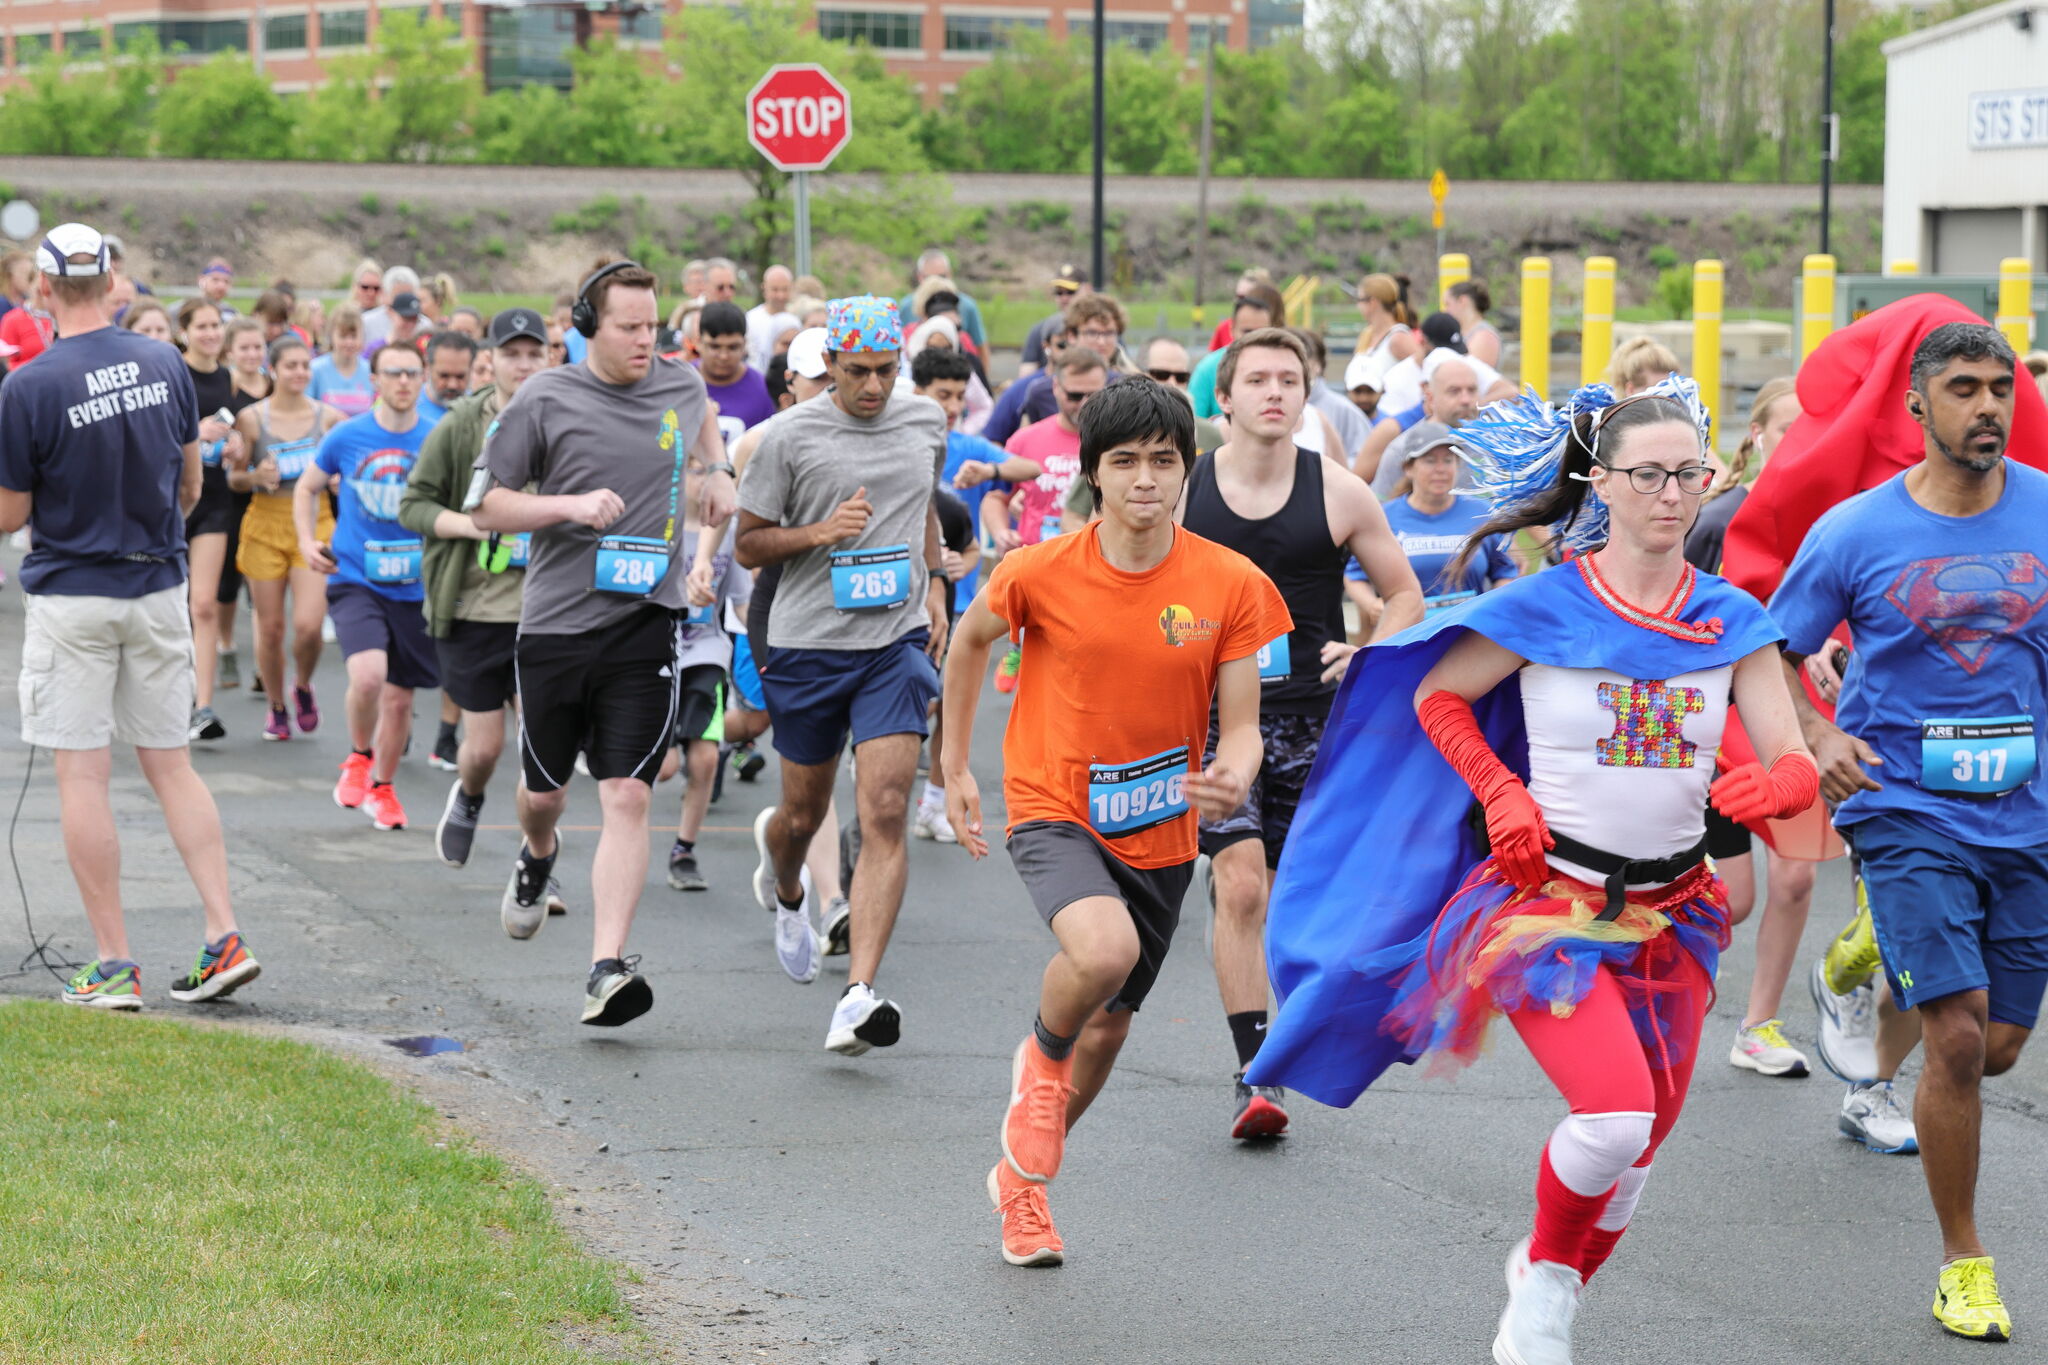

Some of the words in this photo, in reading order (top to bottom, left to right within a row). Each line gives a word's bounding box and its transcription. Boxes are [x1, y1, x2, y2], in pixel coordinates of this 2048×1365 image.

[756, 96, 844, 139] STOP
[1974, 100, 2012, 141] STS
[84, 360, 141, 397] AREEP
[67, 391, 122, 430] EVENT
[122, 380, 169, 413] STAFF
[612, 557, 656, 587] 284
[849, 568, 898, 600] 263
[1926, 726, 1954, 736] ARE
[1093, 771, 1119, 781] ARE
[1952, 748, 2008, 783] 317
[1093, 773, 1186, 824] 10926
